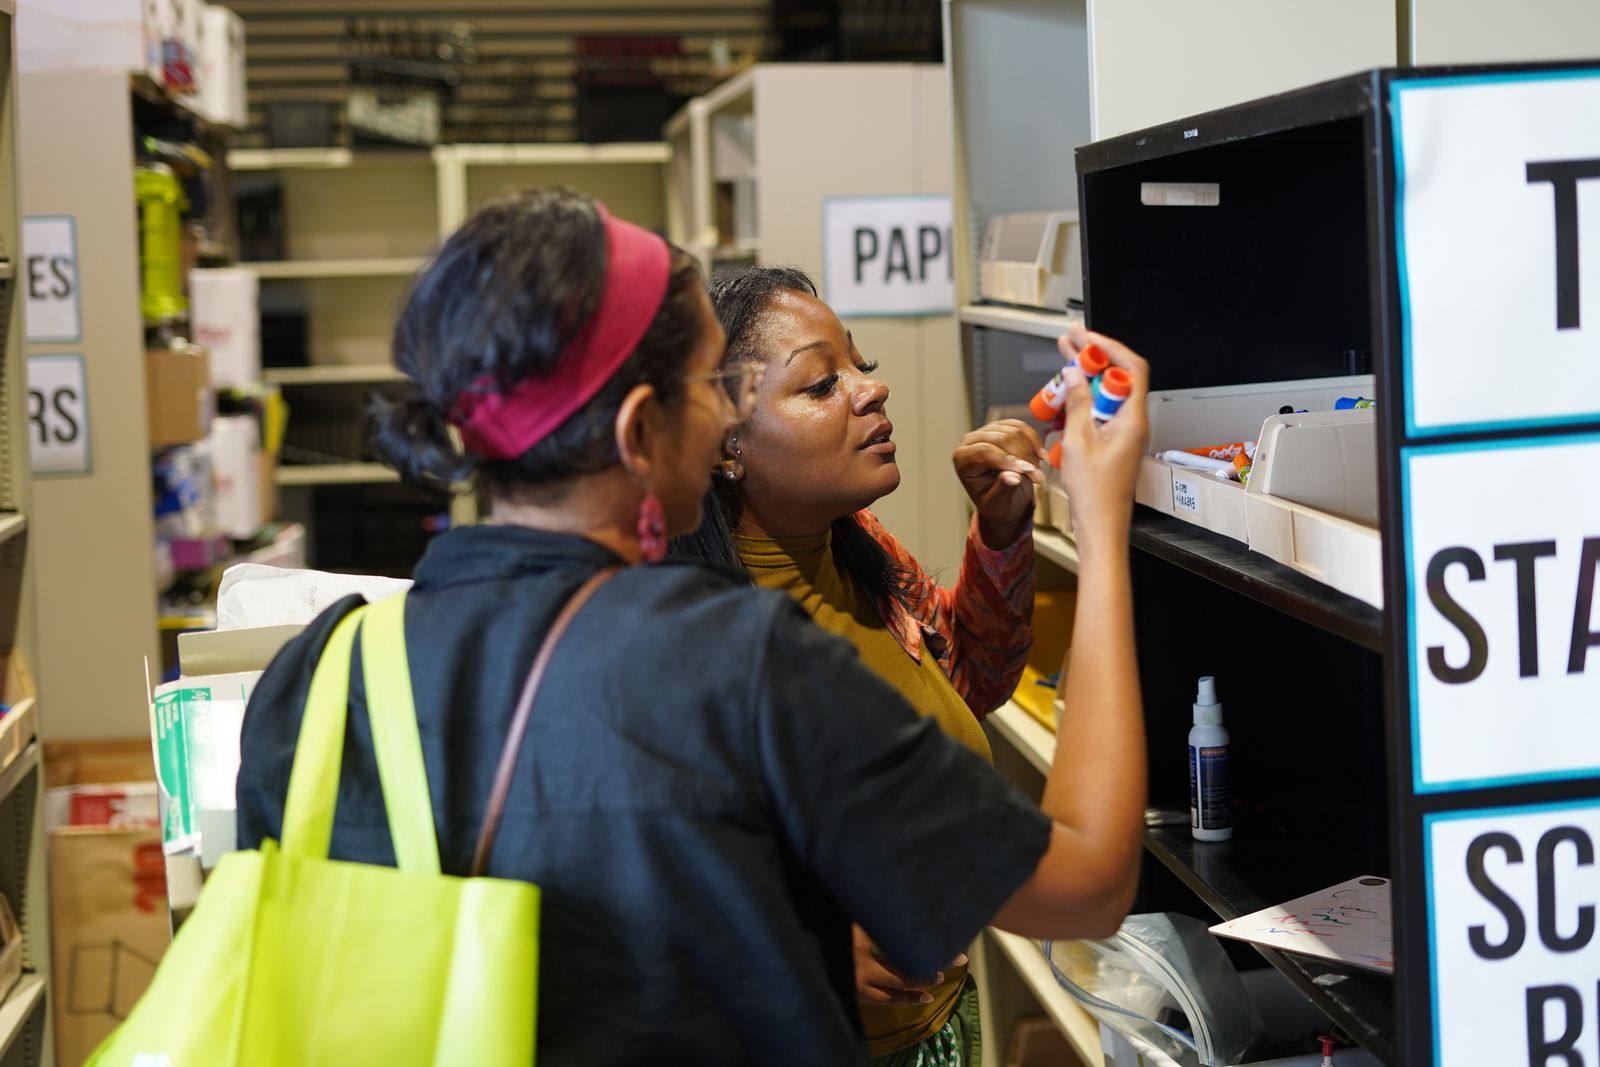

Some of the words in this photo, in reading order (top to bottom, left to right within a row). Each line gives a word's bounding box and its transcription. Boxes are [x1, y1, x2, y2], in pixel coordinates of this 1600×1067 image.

[27, 256, 73, 300] ES
[1526, 158, 1600, 331] T
[1466, 825, 1596, 961] SC
